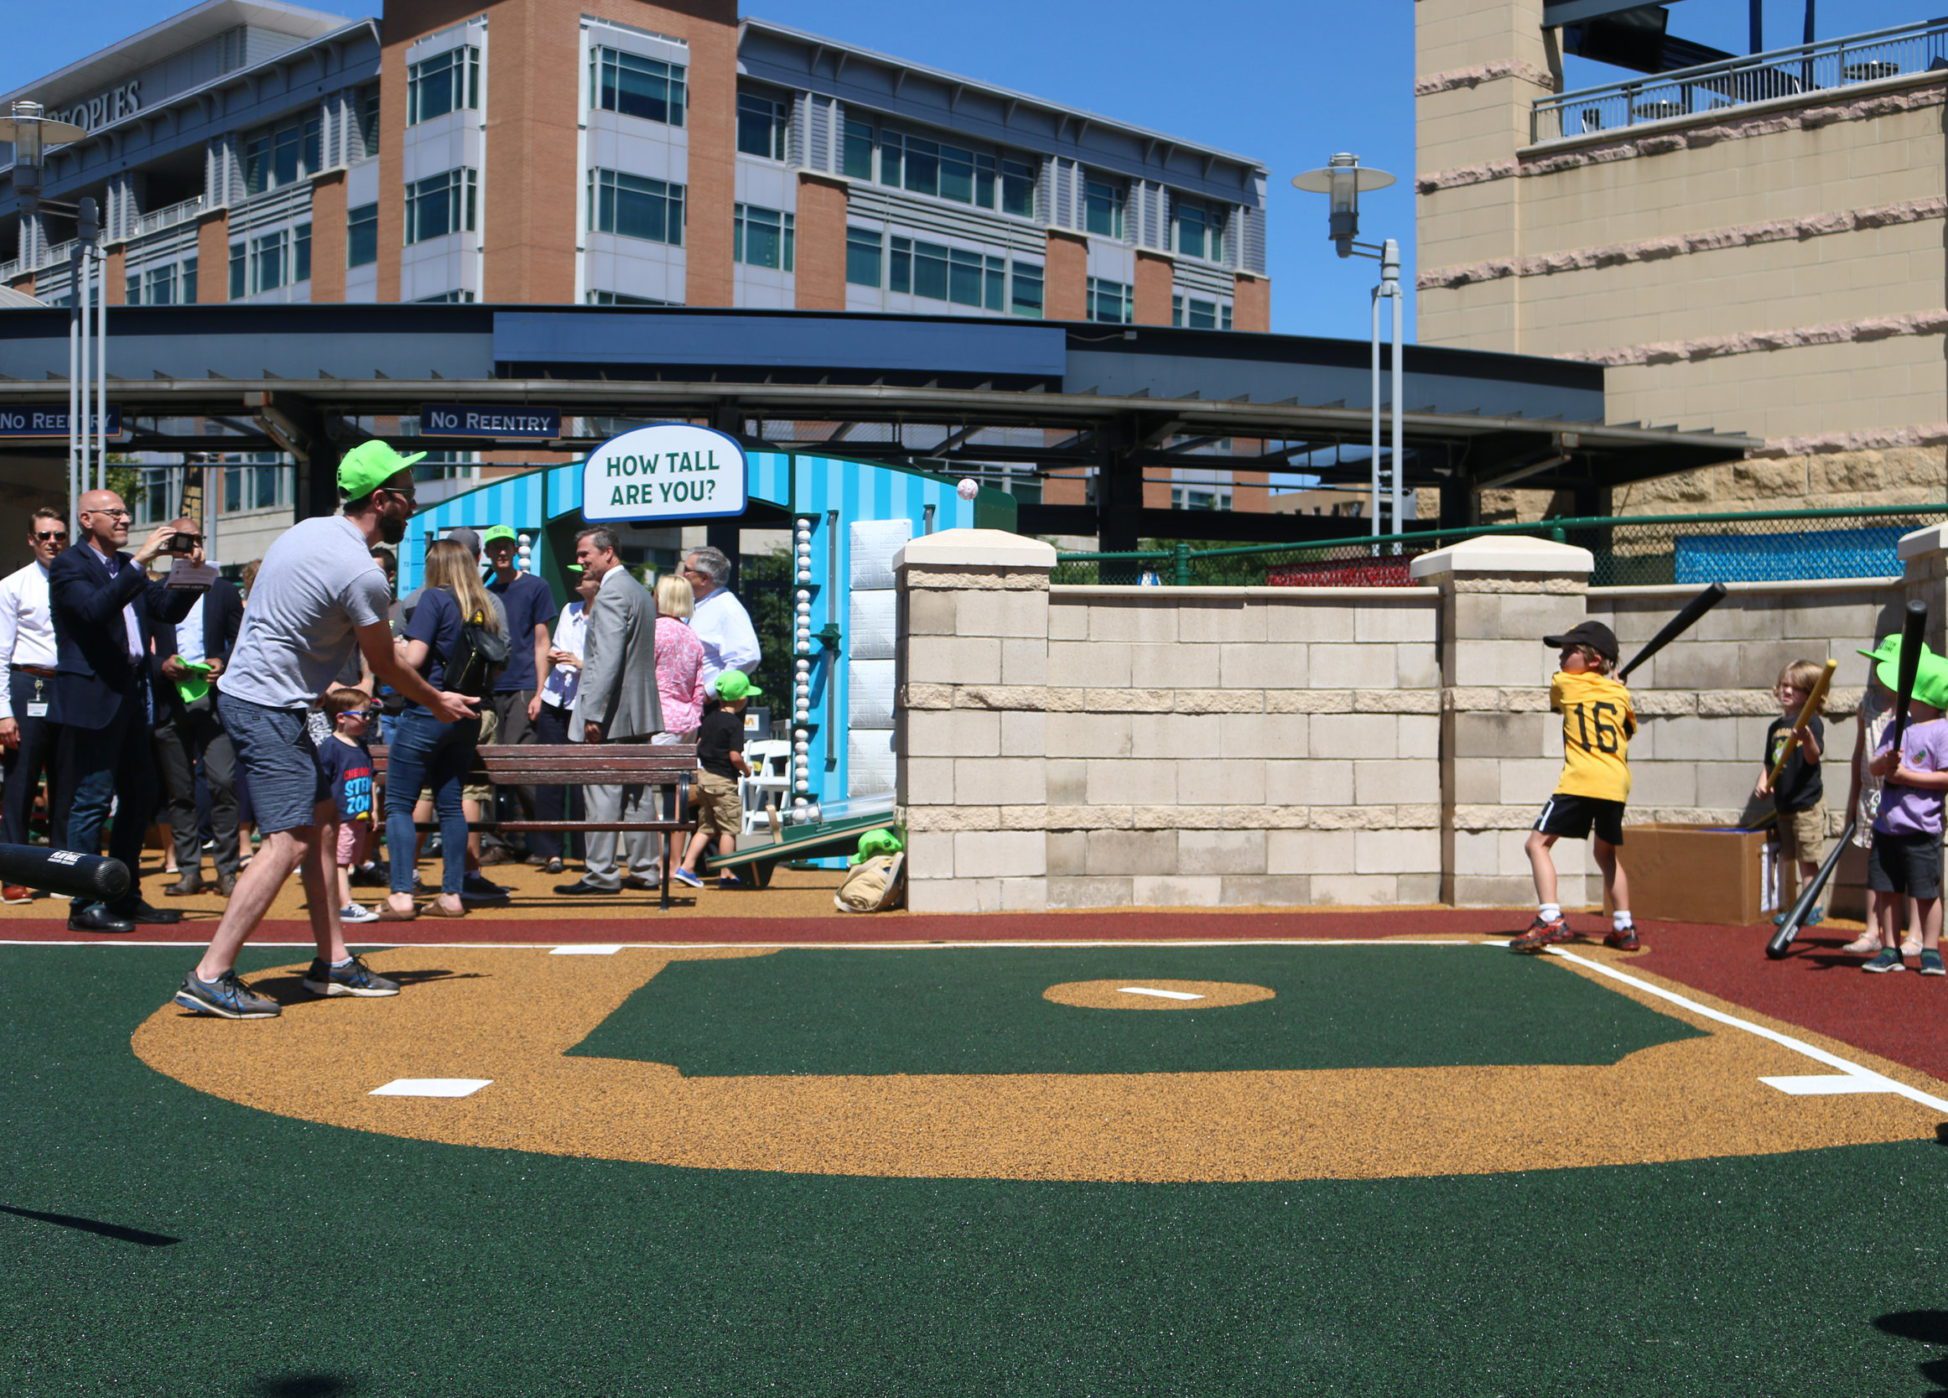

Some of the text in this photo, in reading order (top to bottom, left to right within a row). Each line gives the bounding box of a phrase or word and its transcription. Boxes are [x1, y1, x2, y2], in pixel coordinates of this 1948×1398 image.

[32, 412, 112, 429] REERY
[431, 411, 551, 431] NO REENTRY
[606, 449, 720, 478] HOW TALL
[610, 478, 716, 506] ARE YOU?
[1574, 700, 1618, 754] 16
